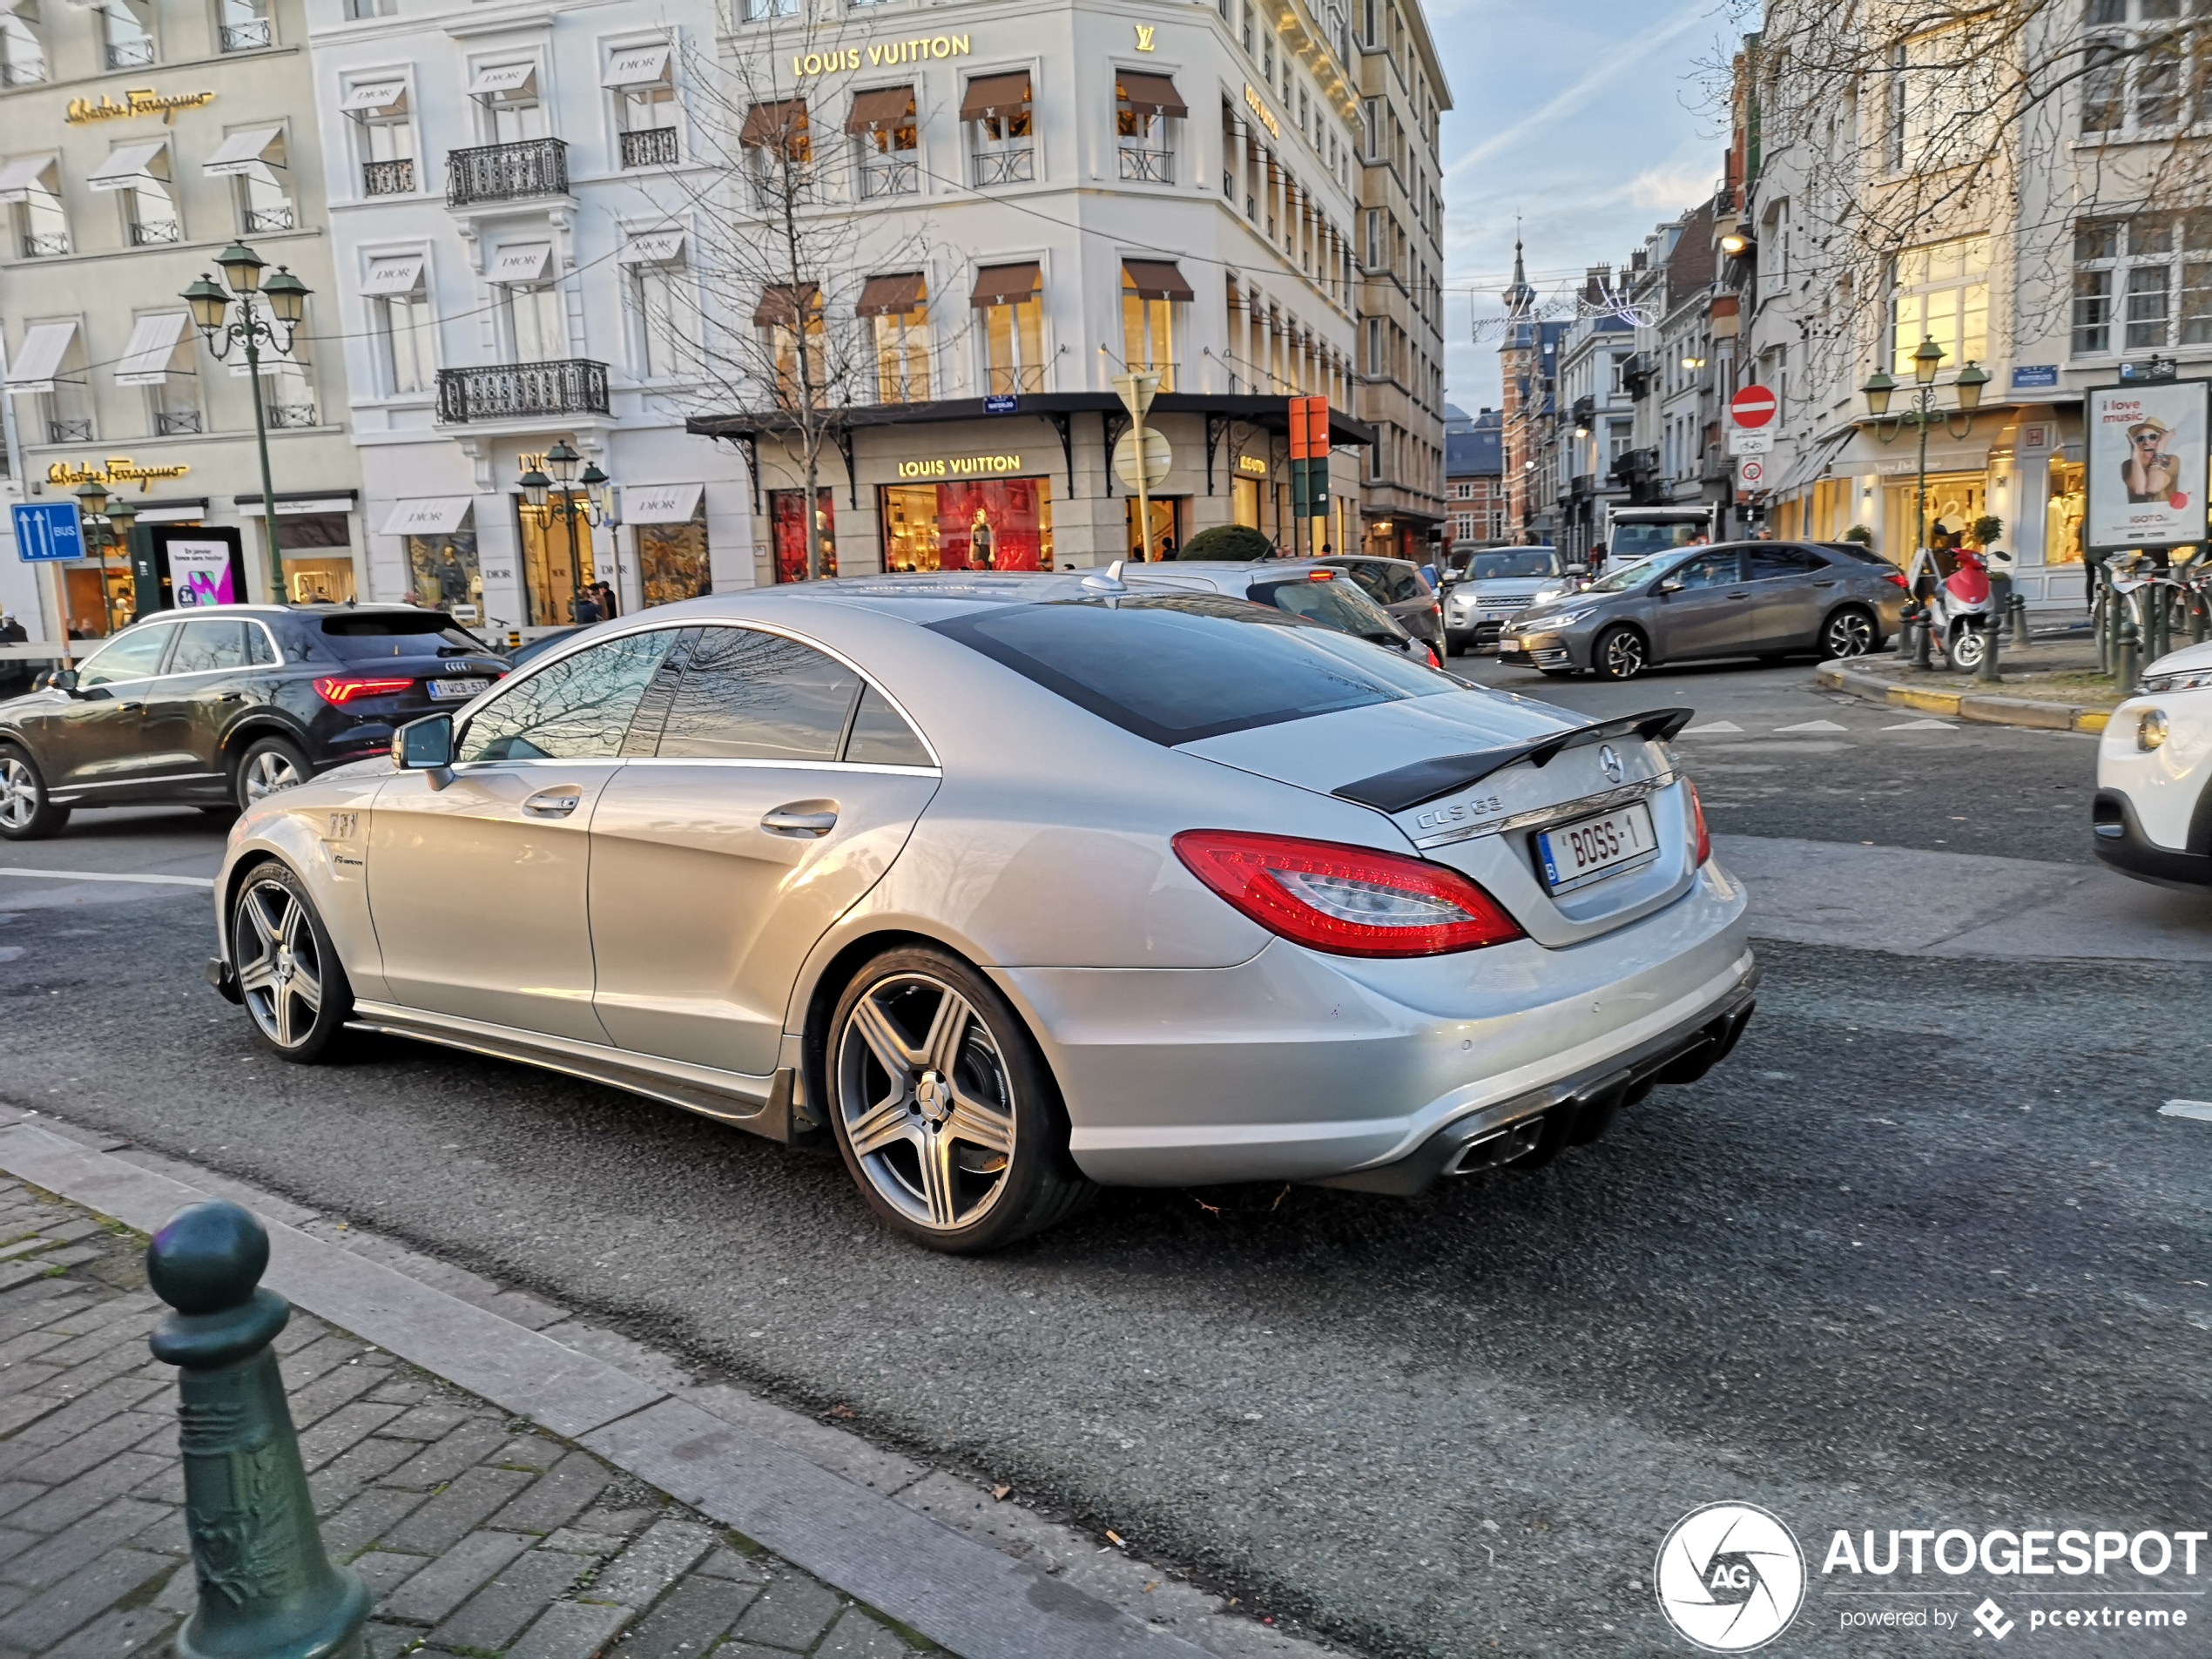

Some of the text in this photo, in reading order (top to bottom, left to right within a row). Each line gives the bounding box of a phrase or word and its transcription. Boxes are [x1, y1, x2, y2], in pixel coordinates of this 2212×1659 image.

[1135, 25, 1155, 51] LV
[793, 34, 971, 77] LOUIS VUITTON
[618, 57, 656, 71] DIOR
[484, 71, 520, 83] DIOR
[357, 89, 393, 101] DIOR
[502, 254, 537, 267] DIOR
[375, 267, 410, 280] DIOR
[2121, 363, 2133, 378] P
[2102, 400, 2141, 411] i love
[2102, 411, 2144, 423] music
[518, 453, 553, 473] DIO
[899, 455, 1021, 478] LOUIS VUITTON
[638, 499, 676, 511] DIOR
[408, 511, 443, 523] DIOR
[53, 525, 76, 537] BUS
[486, 569, 512, 579] DIOR
[601, 564, 627, 574] DIR
[1416, 795, 1504, 829] CLS 63
[1545, 862, 1557, 881] B
